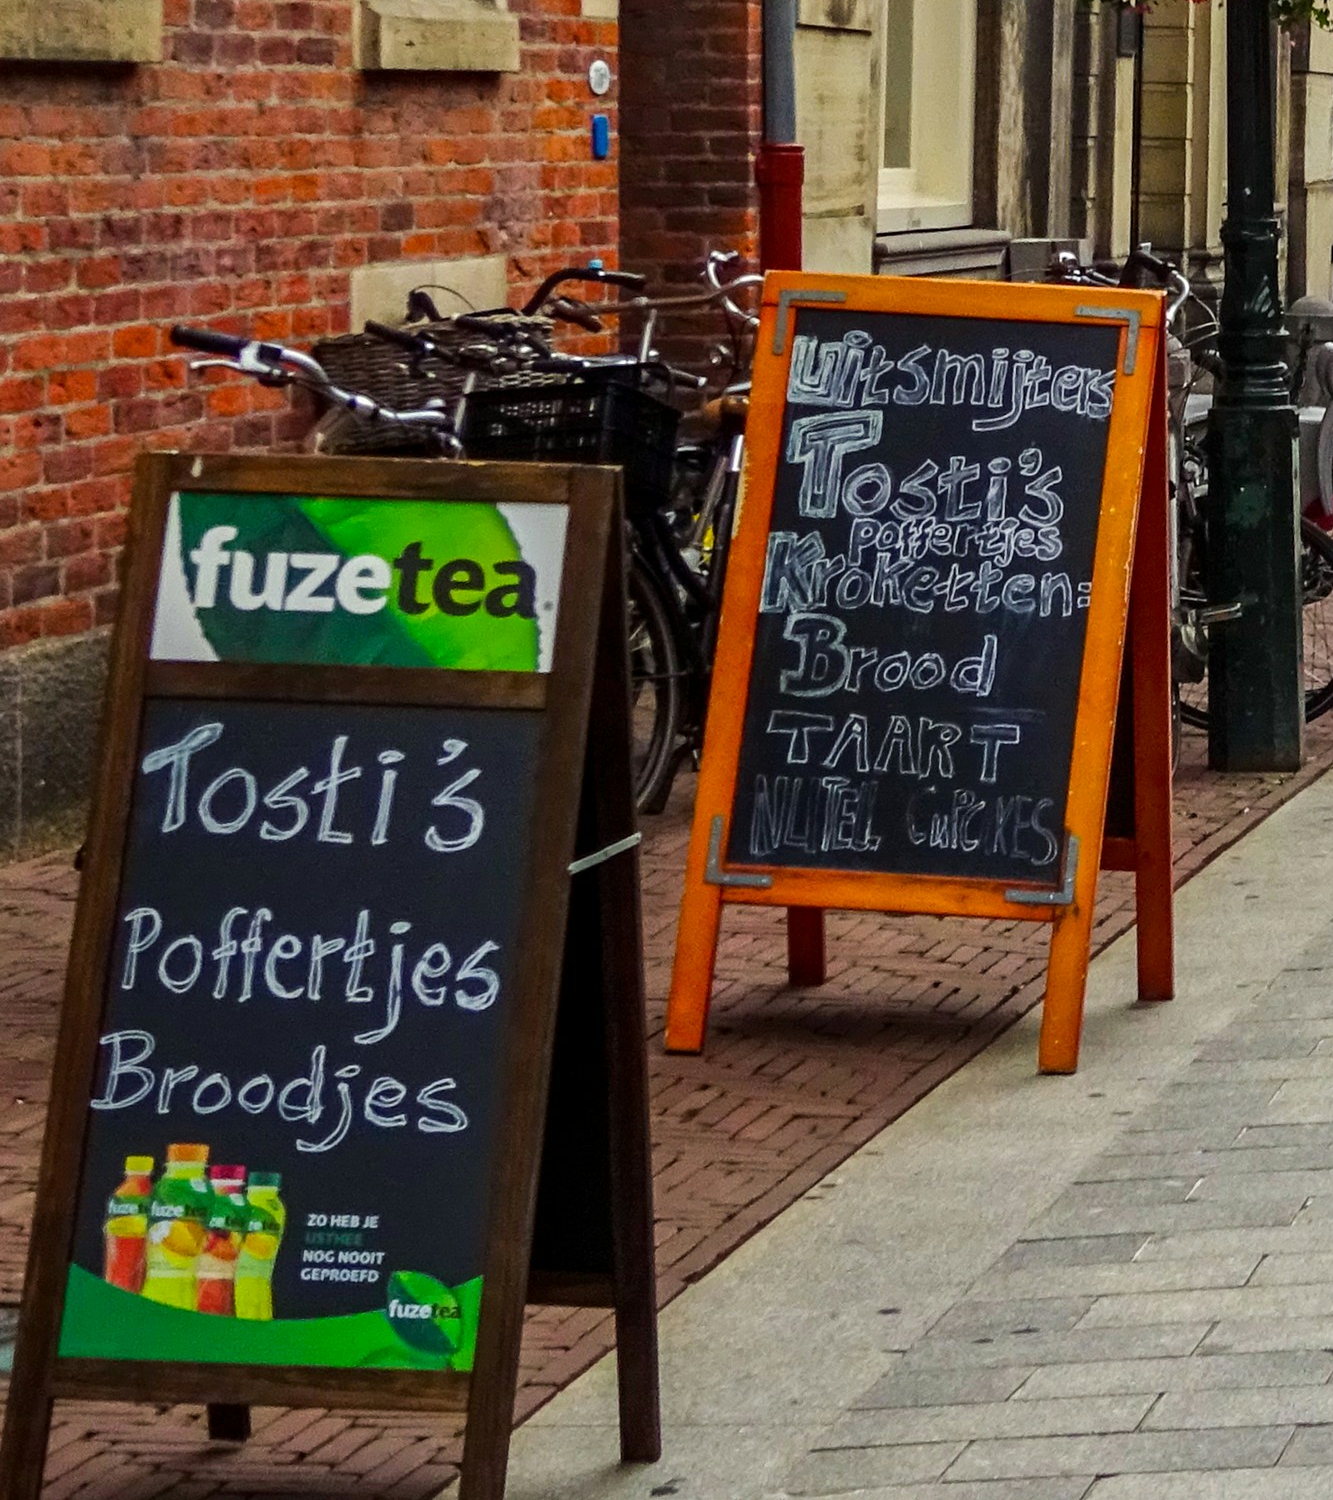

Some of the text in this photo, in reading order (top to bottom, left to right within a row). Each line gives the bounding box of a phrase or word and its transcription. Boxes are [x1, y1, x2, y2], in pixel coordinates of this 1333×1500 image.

[786, 410, 1063, 526] Tosti's
[190, 525, 538, 619] fuzetea
[849, 516, 1064, 567] poffertjes
[780, 614, 997, 698] Brood
[766, 711, 1021, 783] TAART
[142, 721, 485, 855] Tosti's
[120, 905, 501, 1043] Poffertjes
[90, 1029, 469, 1153] Broodjes
[302, 1249, 385, 1265] NOG NOOIT
[307, 1213, 380, 1229] ZO HEB JE
[300, 1267, 380, 1283] GEPROEFD
[389, 1299, 462, 1320] fuzetea
